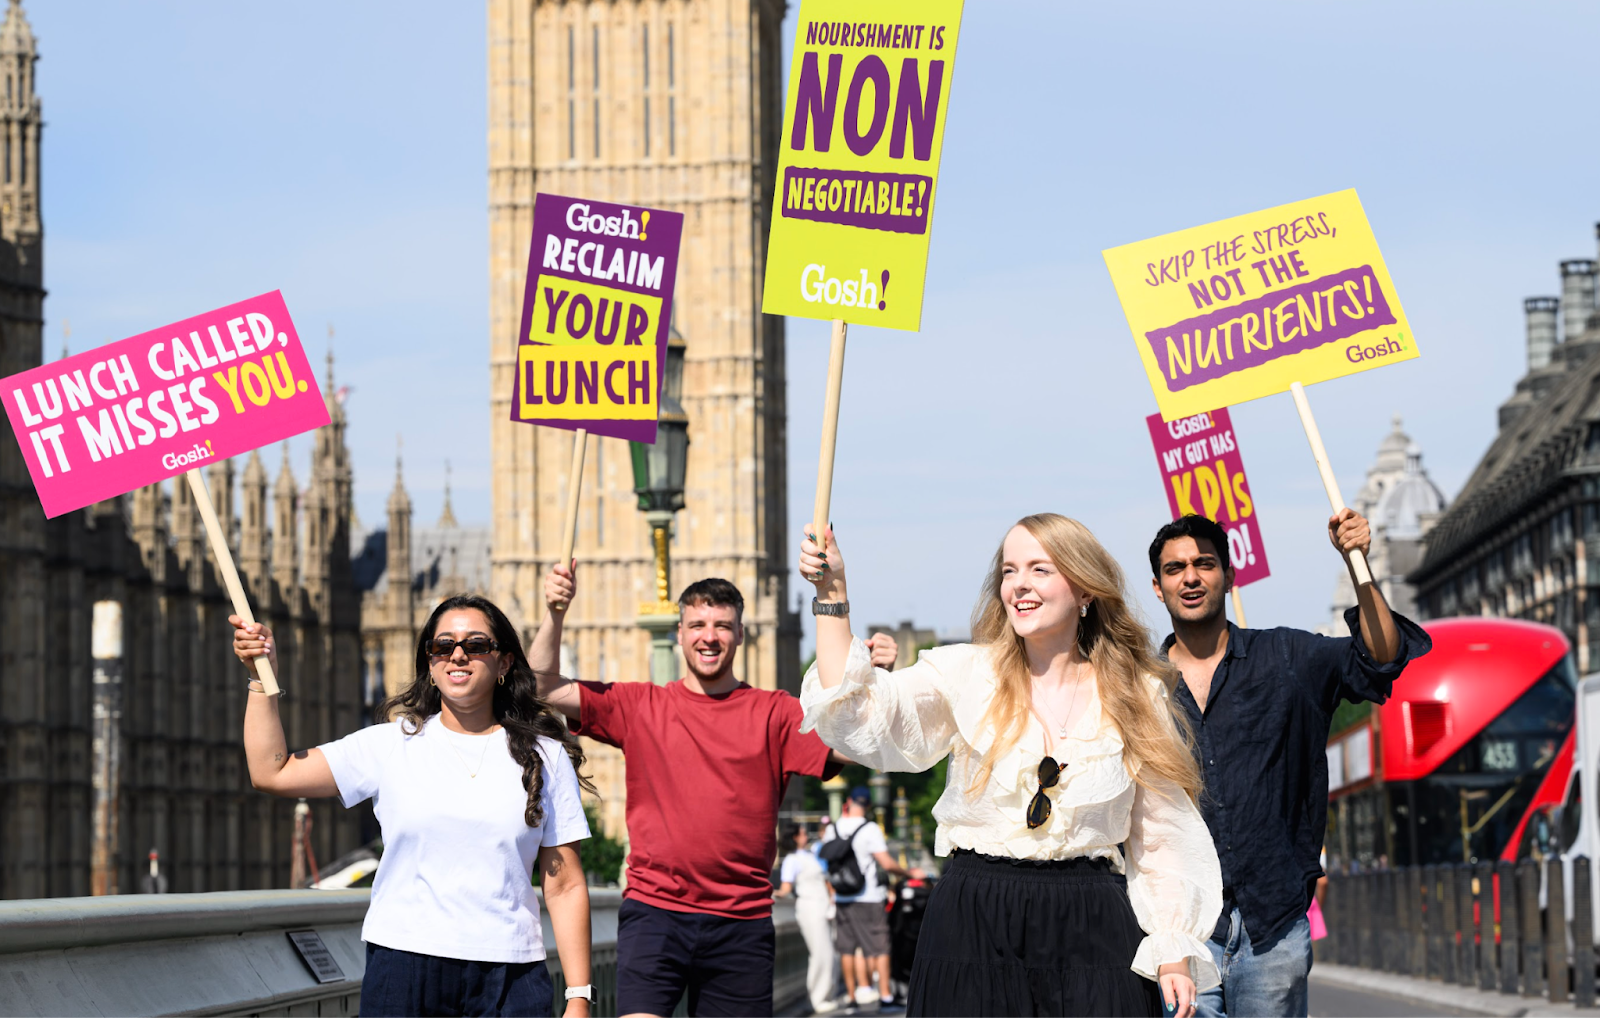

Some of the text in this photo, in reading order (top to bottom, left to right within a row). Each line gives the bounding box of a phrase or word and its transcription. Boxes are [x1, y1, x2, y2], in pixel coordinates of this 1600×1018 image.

[806, 21, 945, 50] NOURISHMENT IS
[791, 52, 945, 161] NON
[566, 203, 650, 241] Gosh!
[786, 176, 927, 218] NEGOTIABLE!
[542, 234, 665, 290] RECLAIM
[1145, 212, 1337, 286] SKIP THE STRESS,
[800, 263, 890, 311] Gosh!
[1187, 249, 1310, 309] NOT THE
[543, 287, 649, 345] YOUR
[1165, 275, 1375, 380] NUTRIENTS!
[13, 312, 288, 427] LUNCH CALLED,
[1345, 332, 1408, 363] Gosh!
[525, 360, 650, 405] LUNCH
[29, 351, 308, 478] IT MISSES YOU.
[162, 440, 215, 471] Gosh!
[1162, 430, 1235, 473] MY GUT HAS
[1170, 459, 1253, 524] KPIs
[1227, 523, 1256, 570] O!
